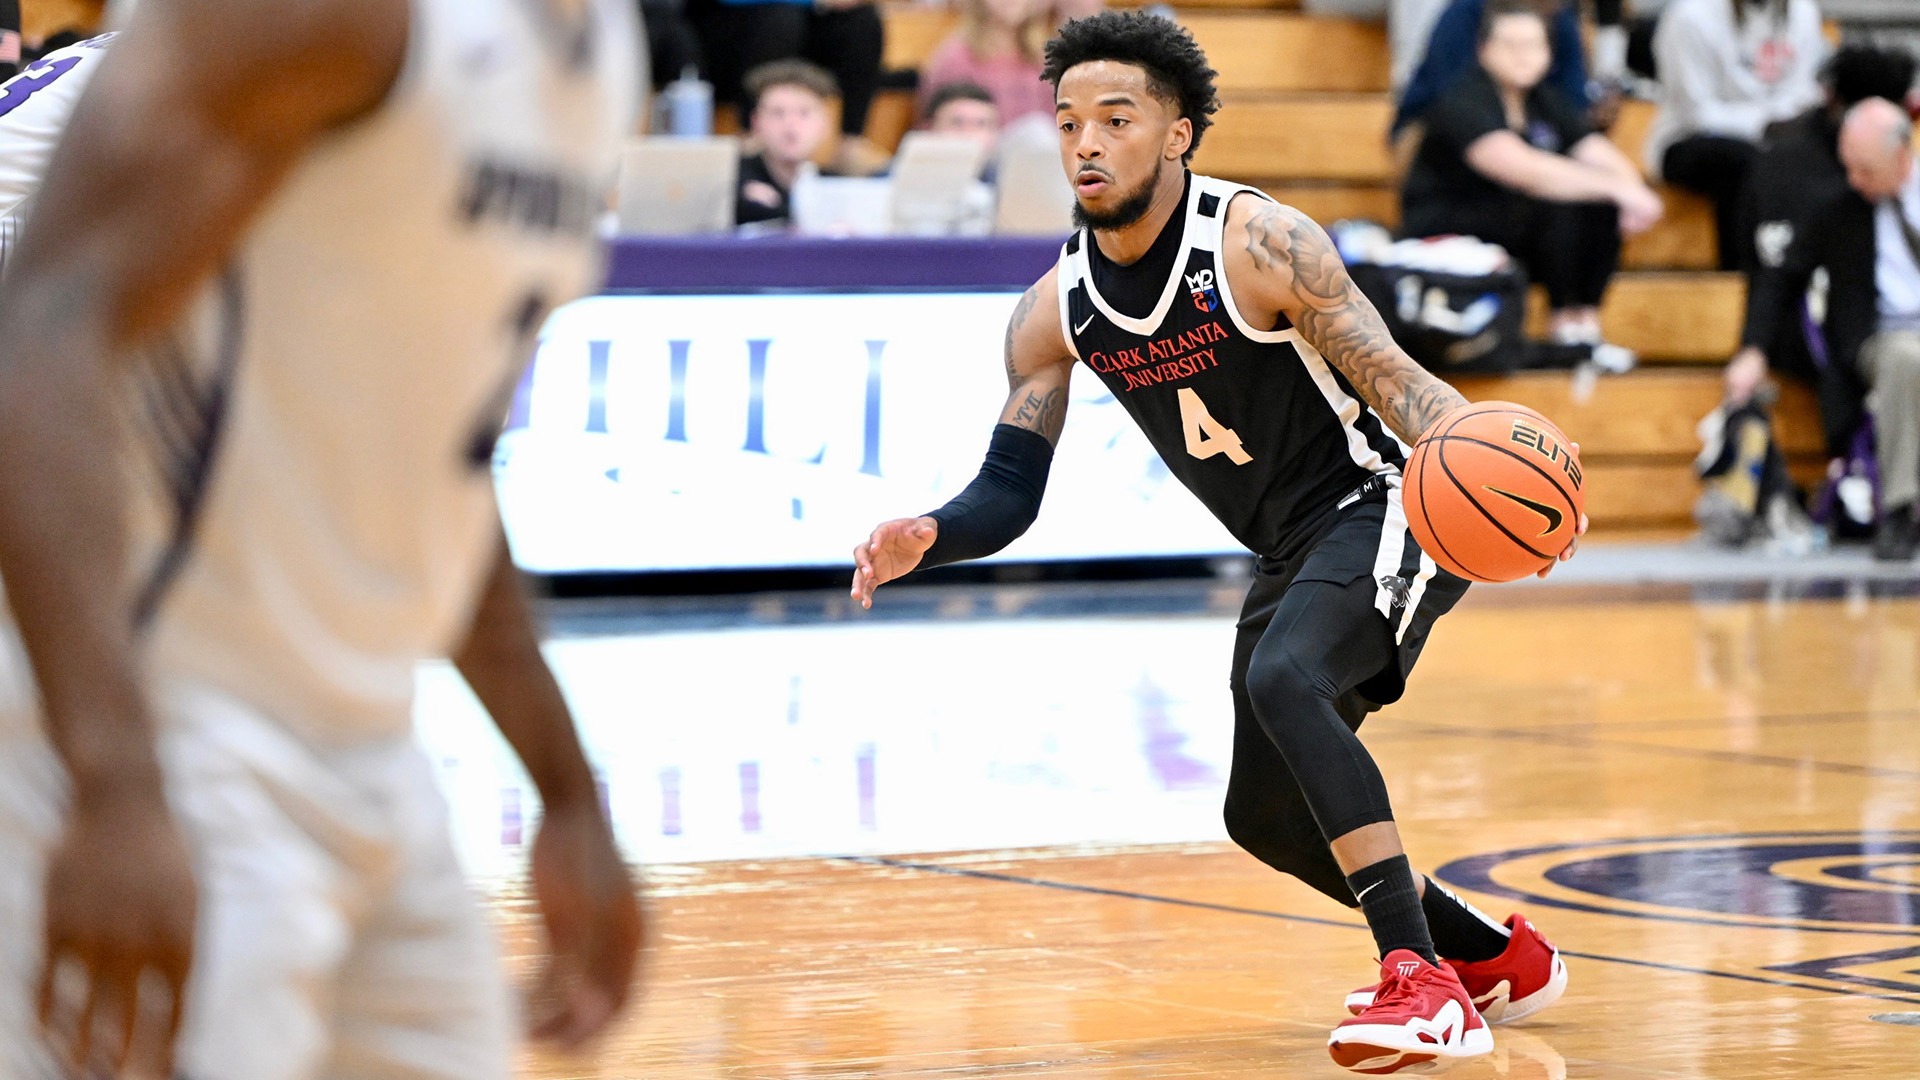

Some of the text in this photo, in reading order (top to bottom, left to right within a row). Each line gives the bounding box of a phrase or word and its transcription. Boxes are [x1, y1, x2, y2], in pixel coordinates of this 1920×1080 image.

[1089, 321, 1229, 374] CLARK ATLANTA
[1177, 387, 1254, 466] 4
[1363, 481, 1373, 493] M
[1511, 423, 1583, 492] ELITE
